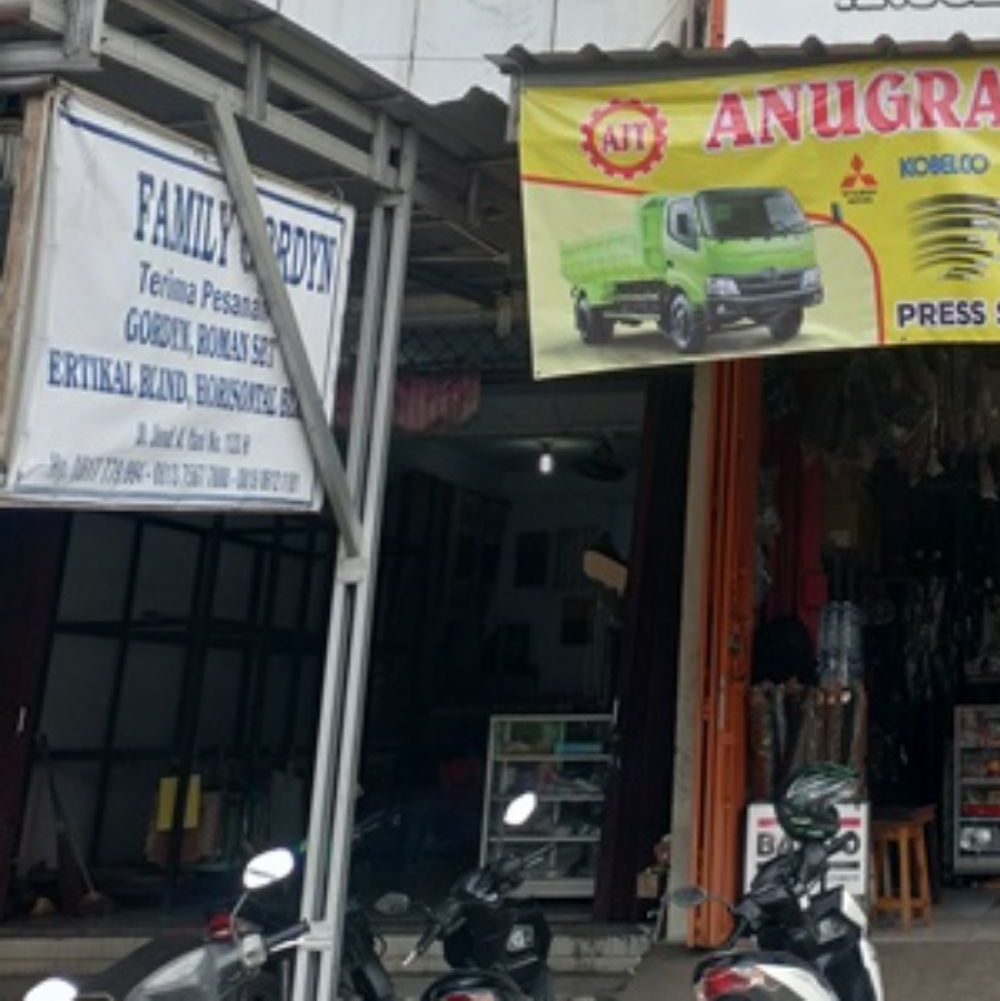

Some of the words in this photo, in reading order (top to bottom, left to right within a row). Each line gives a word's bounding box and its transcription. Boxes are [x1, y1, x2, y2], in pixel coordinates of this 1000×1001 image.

[899, 154, 990, 179] KOBELCO
[134, 170, 239, 268] FAMILY
[138, 260, 198, 306] Terima
[896, 300, 986, 328] PRESS
